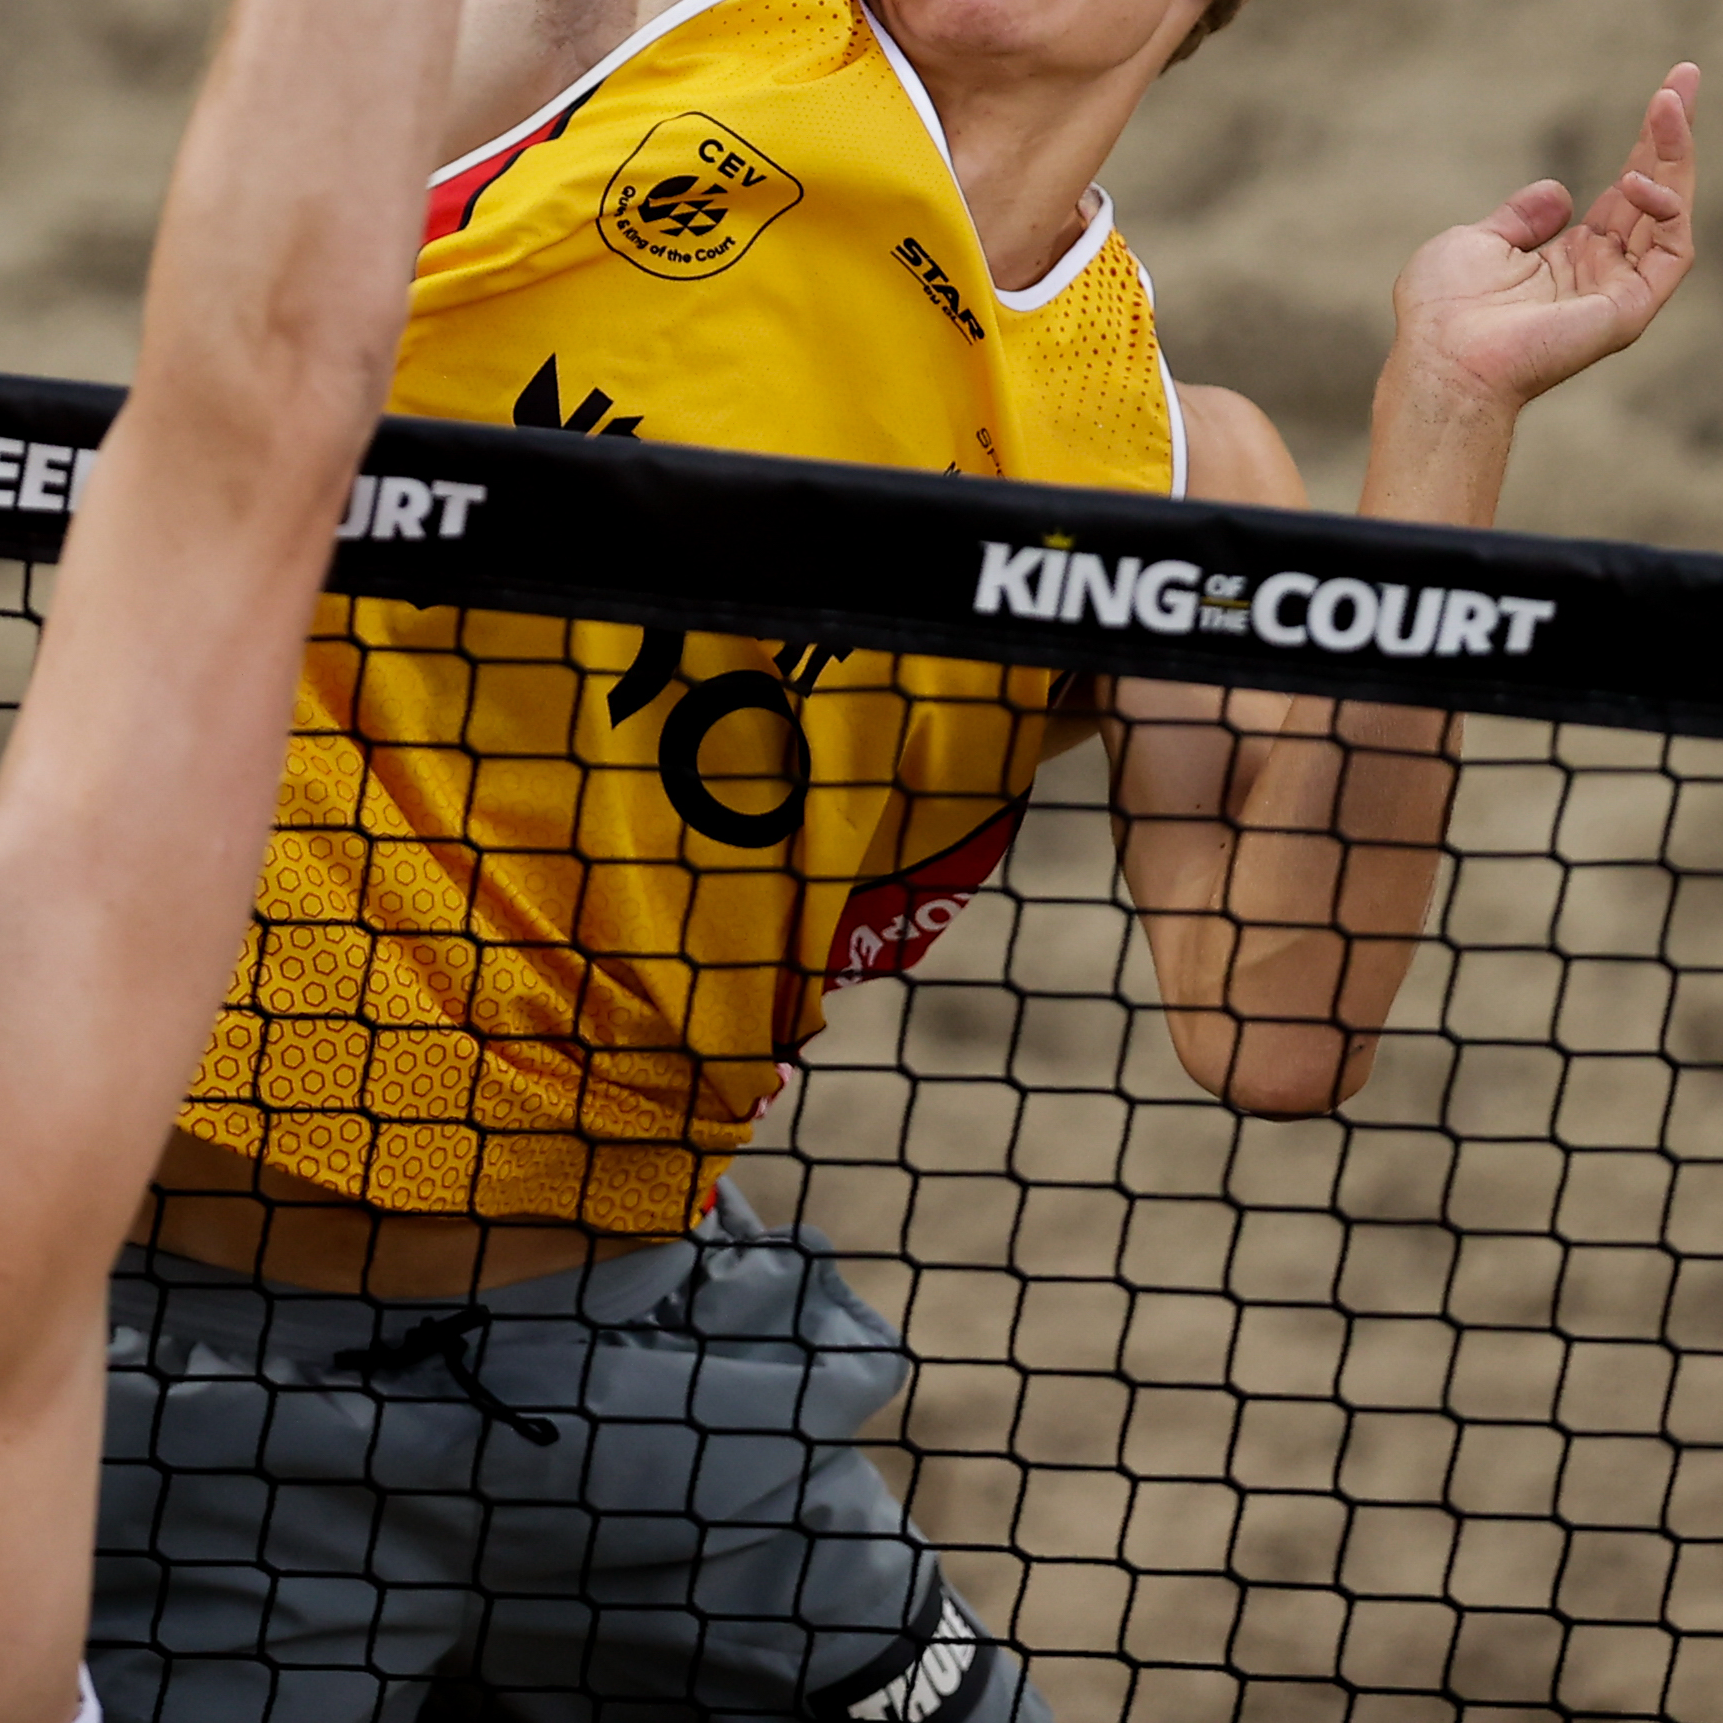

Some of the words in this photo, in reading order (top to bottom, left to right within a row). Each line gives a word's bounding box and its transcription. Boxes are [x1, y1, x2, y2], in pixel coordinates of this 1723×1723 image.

[698, 138, 767, 186] CEV
[622, 229, 650, 250] King
[650, 242, 667, 257] of
[667, 249, 692, 264] the
[695, 236, 736, 262] Court
[895, 237, 985, 341] STAR
[973, 540, 1203, 635] KING
[1204, 574, 1247, 599] OF
[1199, 606, 1250, 633] THE
[1250, 571, 1557, 657] COURT
